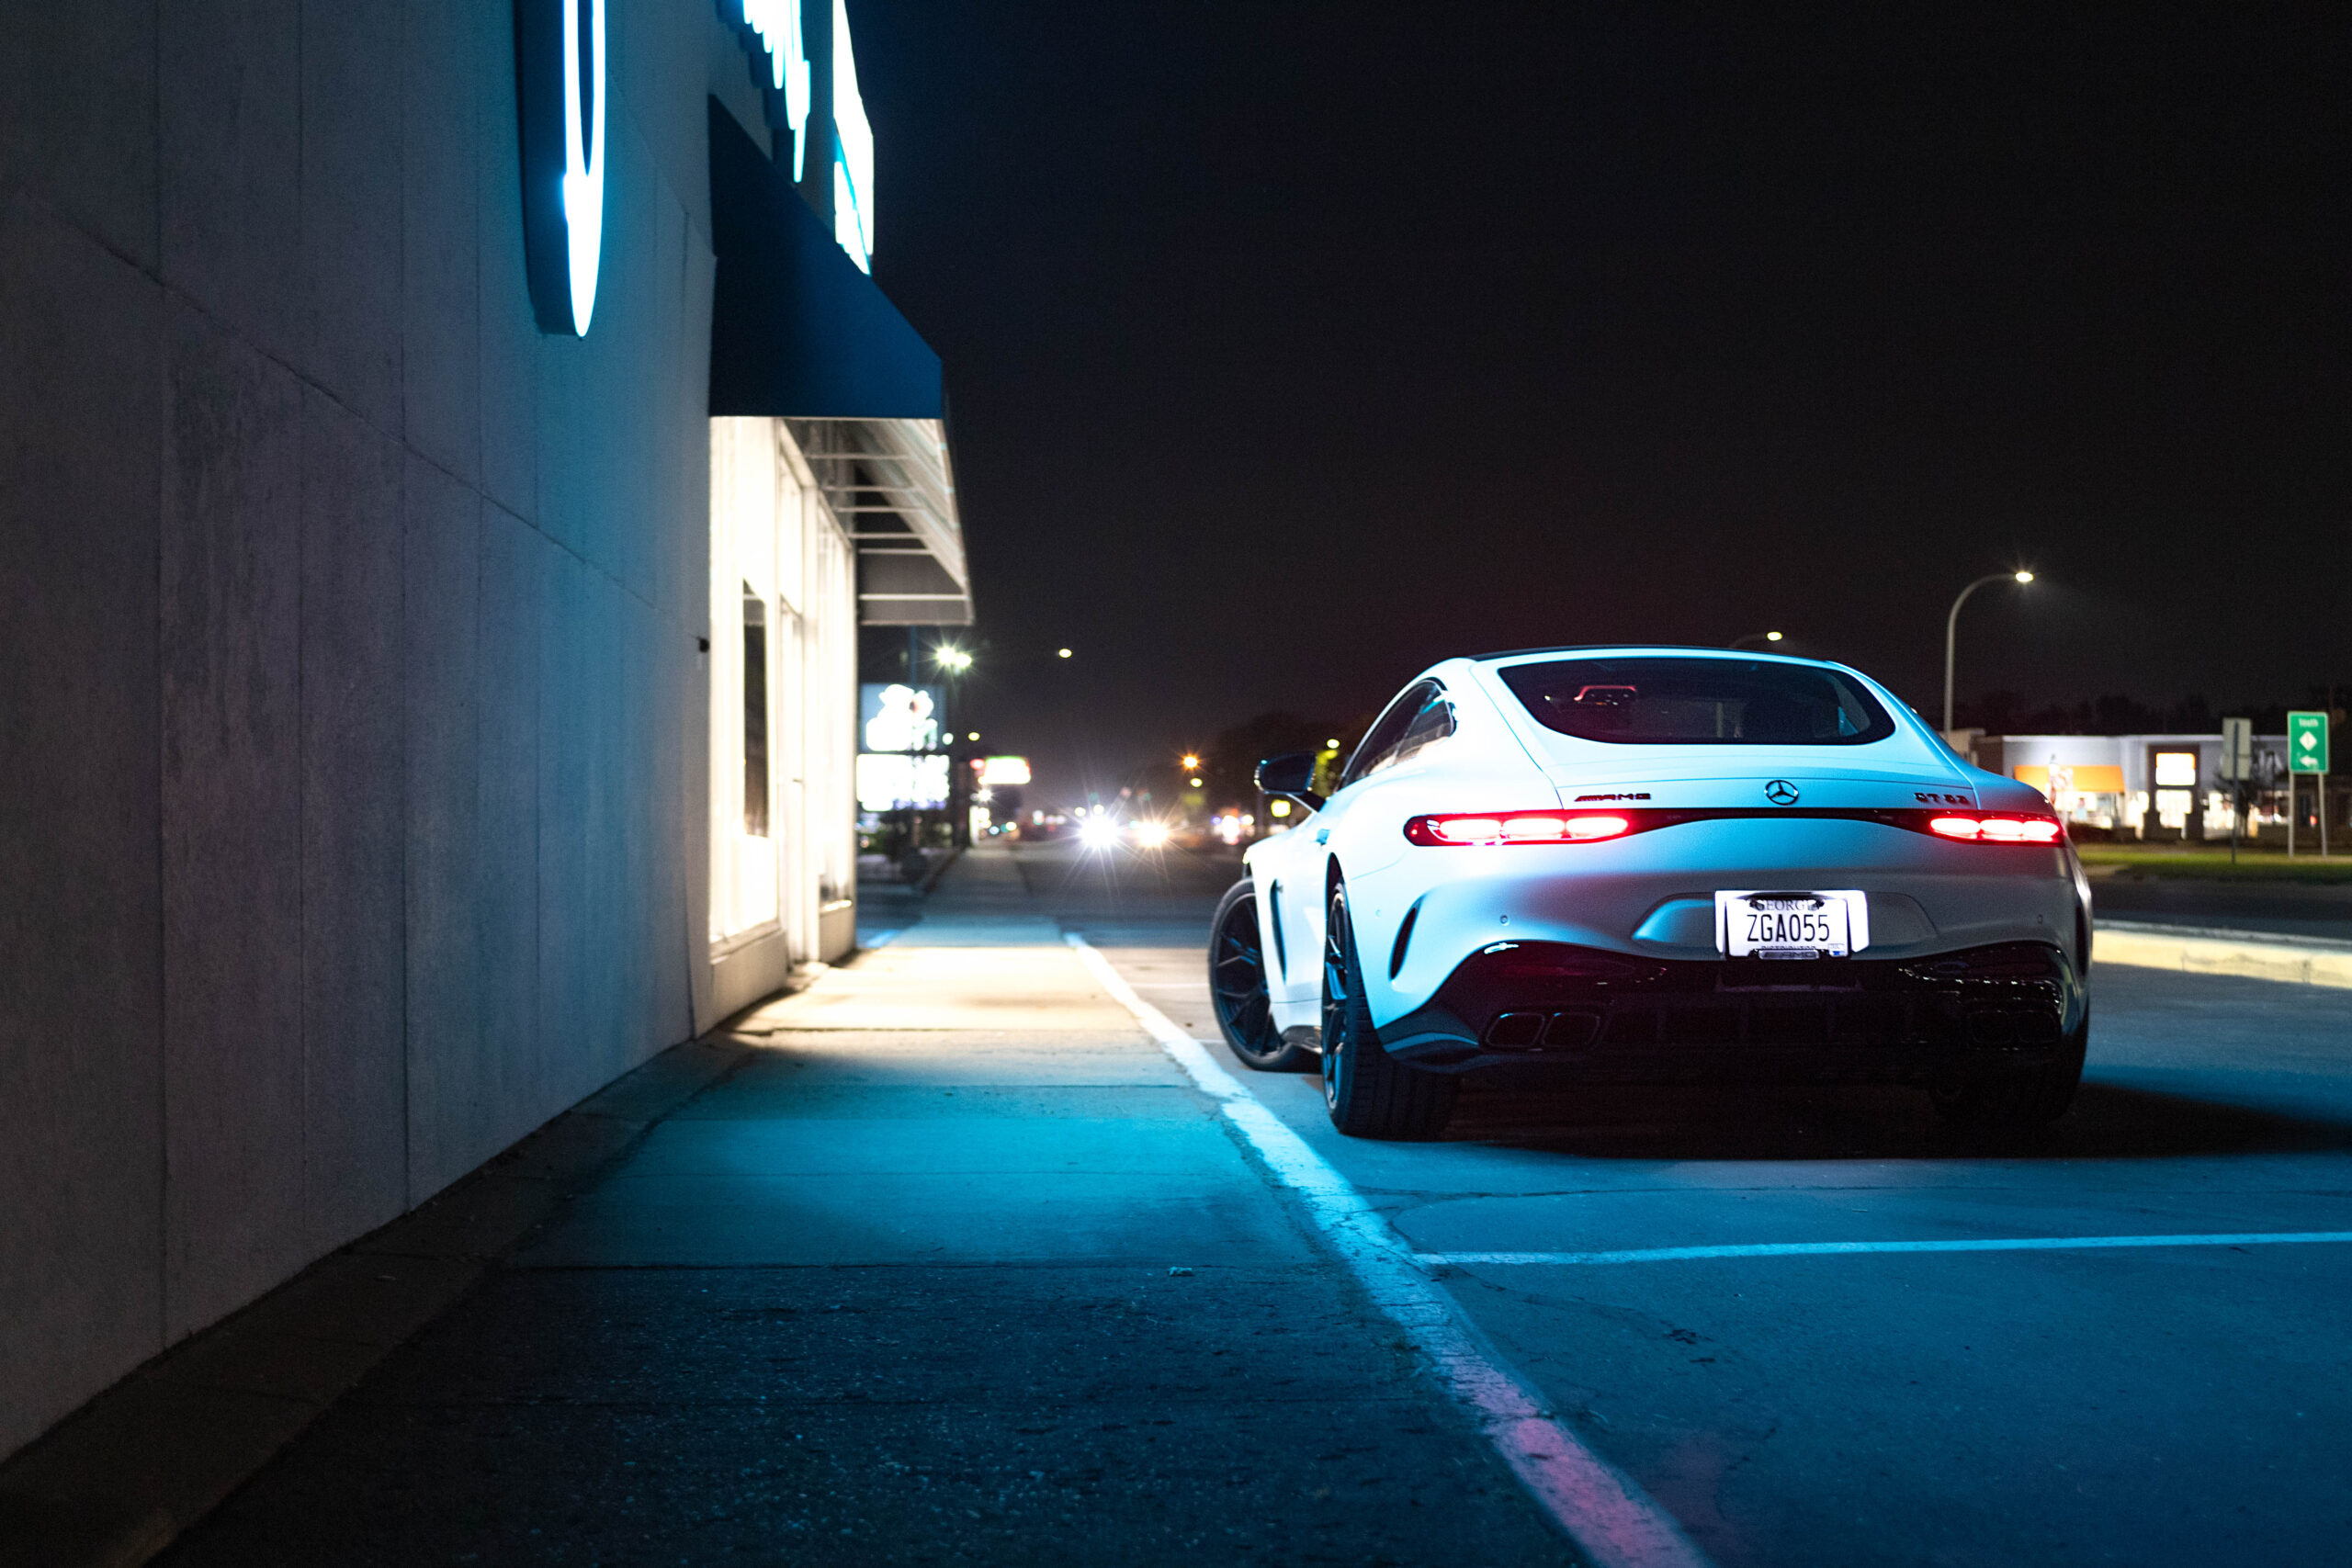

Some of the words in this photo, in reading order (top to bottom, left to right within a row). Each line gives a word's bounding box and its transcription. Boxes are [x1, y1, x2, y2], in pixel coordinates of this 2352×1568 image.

[1915, 792, 1939, 803] GT
[1756, 900, 1820, 911] GEORG
[1747, 913, 1830, 942] ZGA055
